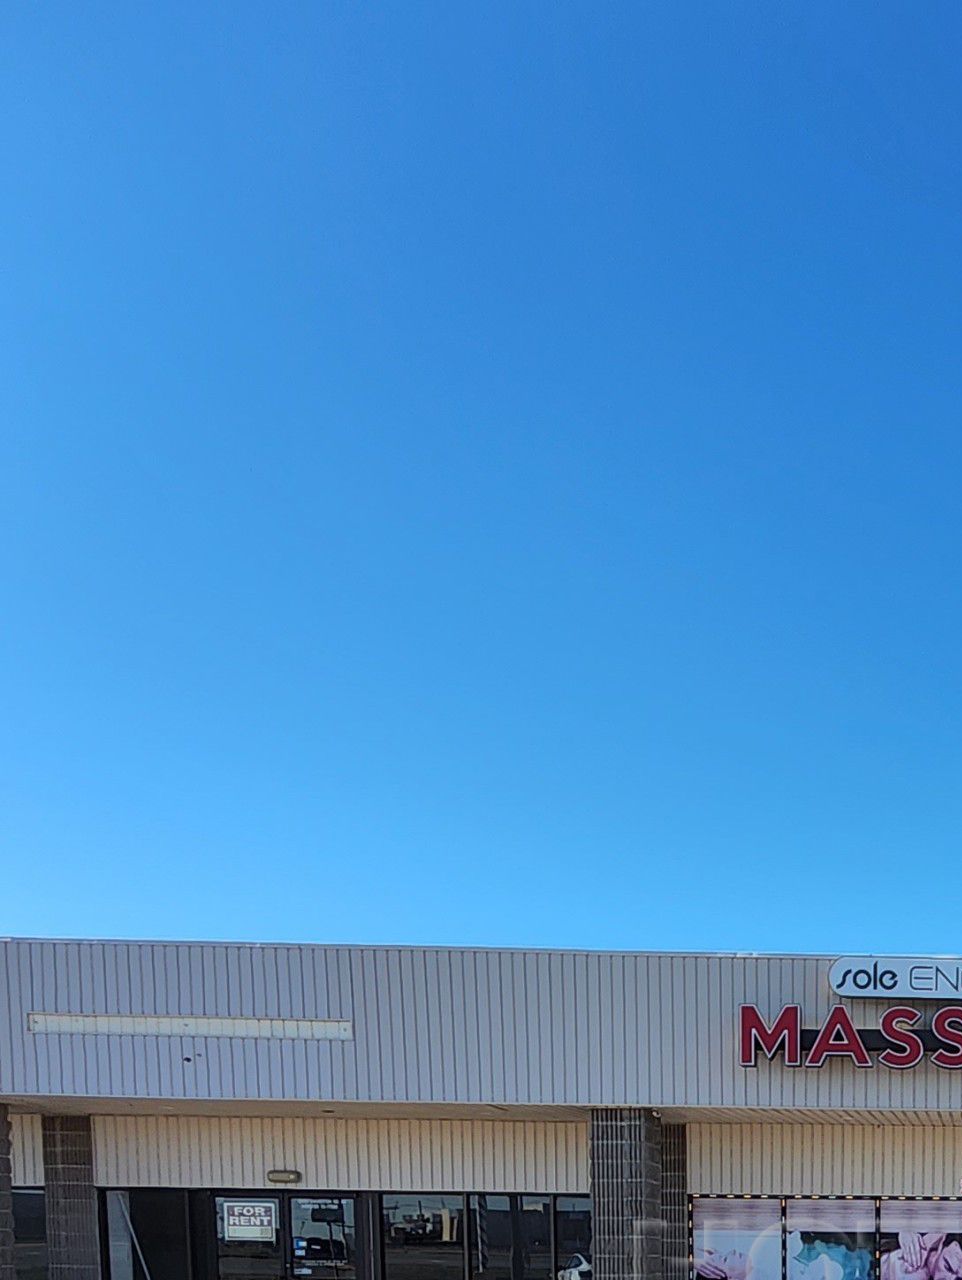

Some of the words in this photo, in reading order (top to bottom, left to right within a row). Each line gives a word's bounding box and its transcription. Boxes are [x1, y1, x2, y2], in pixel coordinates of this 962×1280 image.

[836, 961, 898, 990] sole
[234, 1206, 265, 1216] FOR
[229, 1215, 271, 1226] RENT
